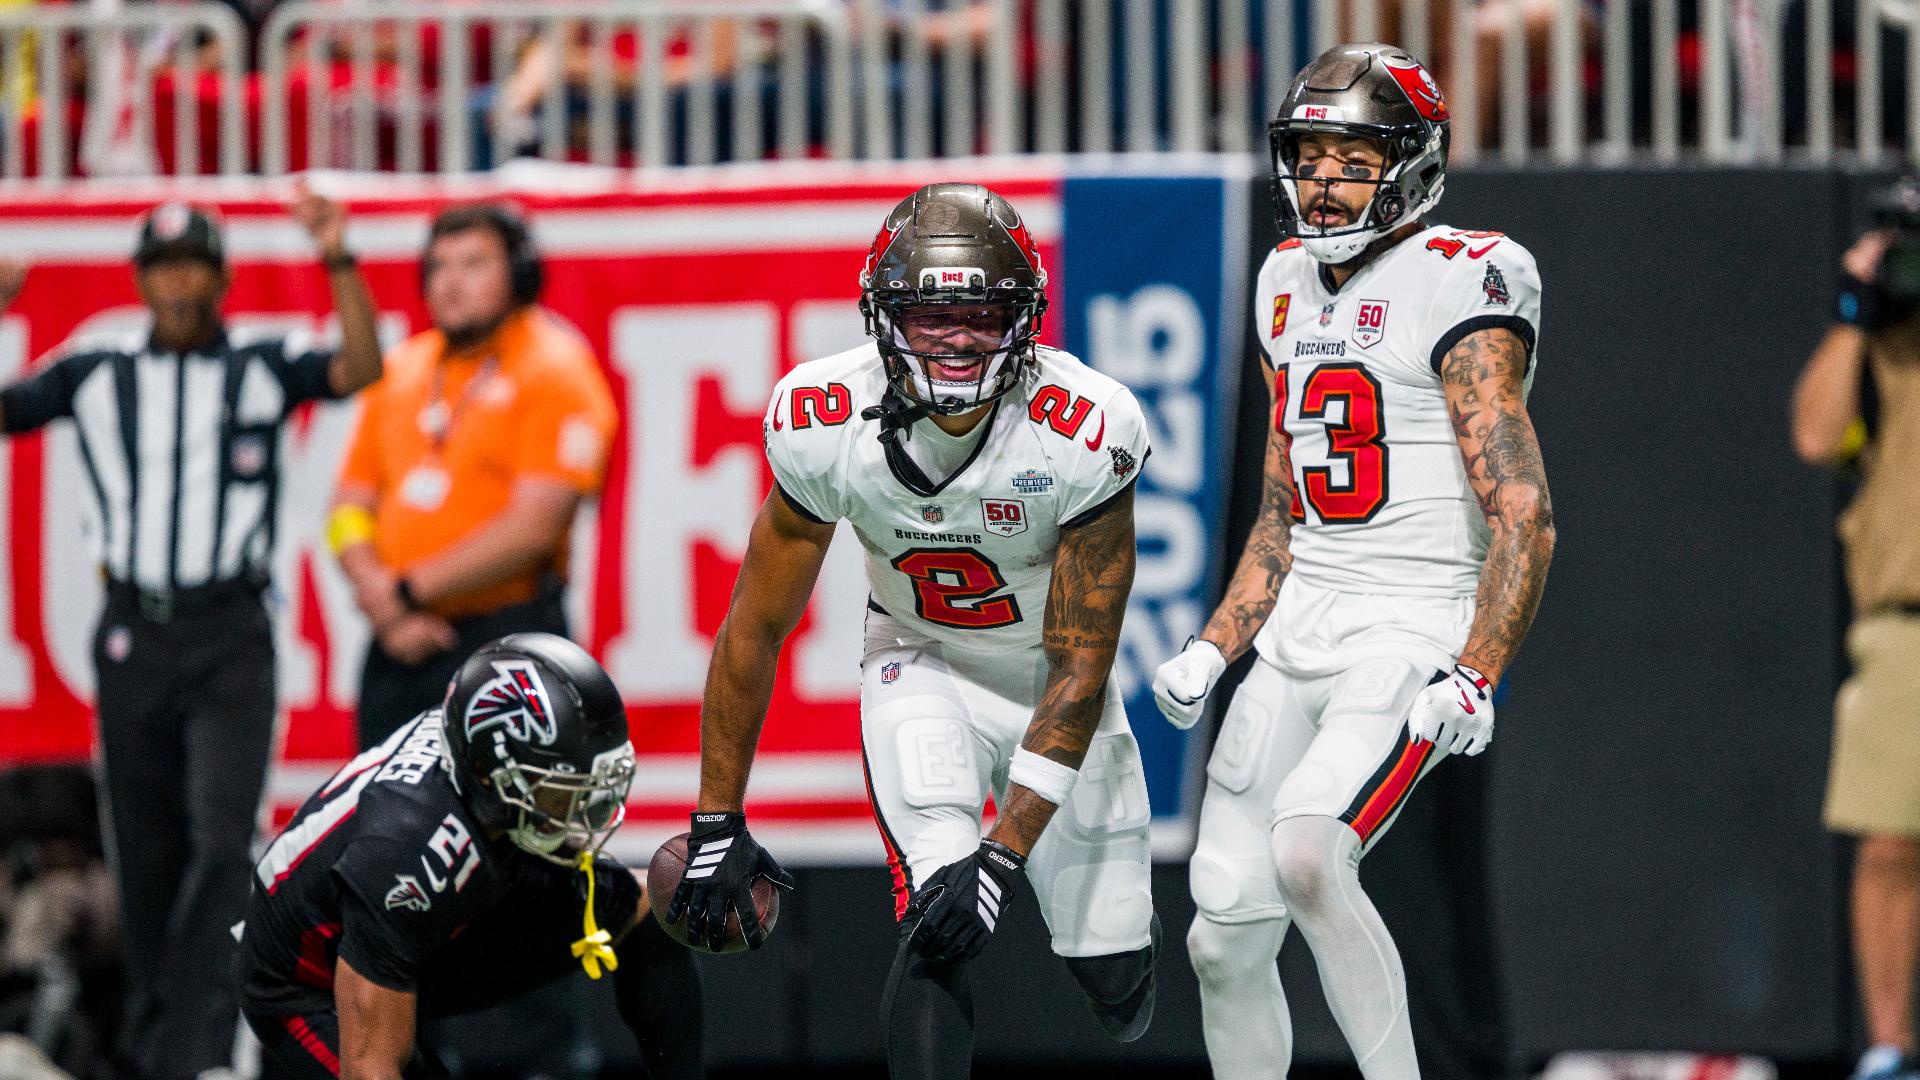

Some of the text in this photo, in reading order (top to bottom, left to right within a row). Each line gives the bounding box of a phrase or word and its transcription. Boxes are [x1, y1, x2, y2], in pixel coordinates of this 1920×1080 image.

[941, 271, 963, 283] BUCS
[1357, 304, 1383, 328] 50
[1295, 341, 1346, 357] BUCCANEERS
[791, 382, 852, 431] 2
[1028, 384, 1096, 441] 2
[985, 502, 1021, 522] 50
[894, 528, 982, 544] BUCCANEERS
[890, 547, 1024, 630] 2
[696, 813, 727, 822] ADIZERO
[427, 812, 481, 893] 21
[988, 851, 1019, 870] ADIZERO
